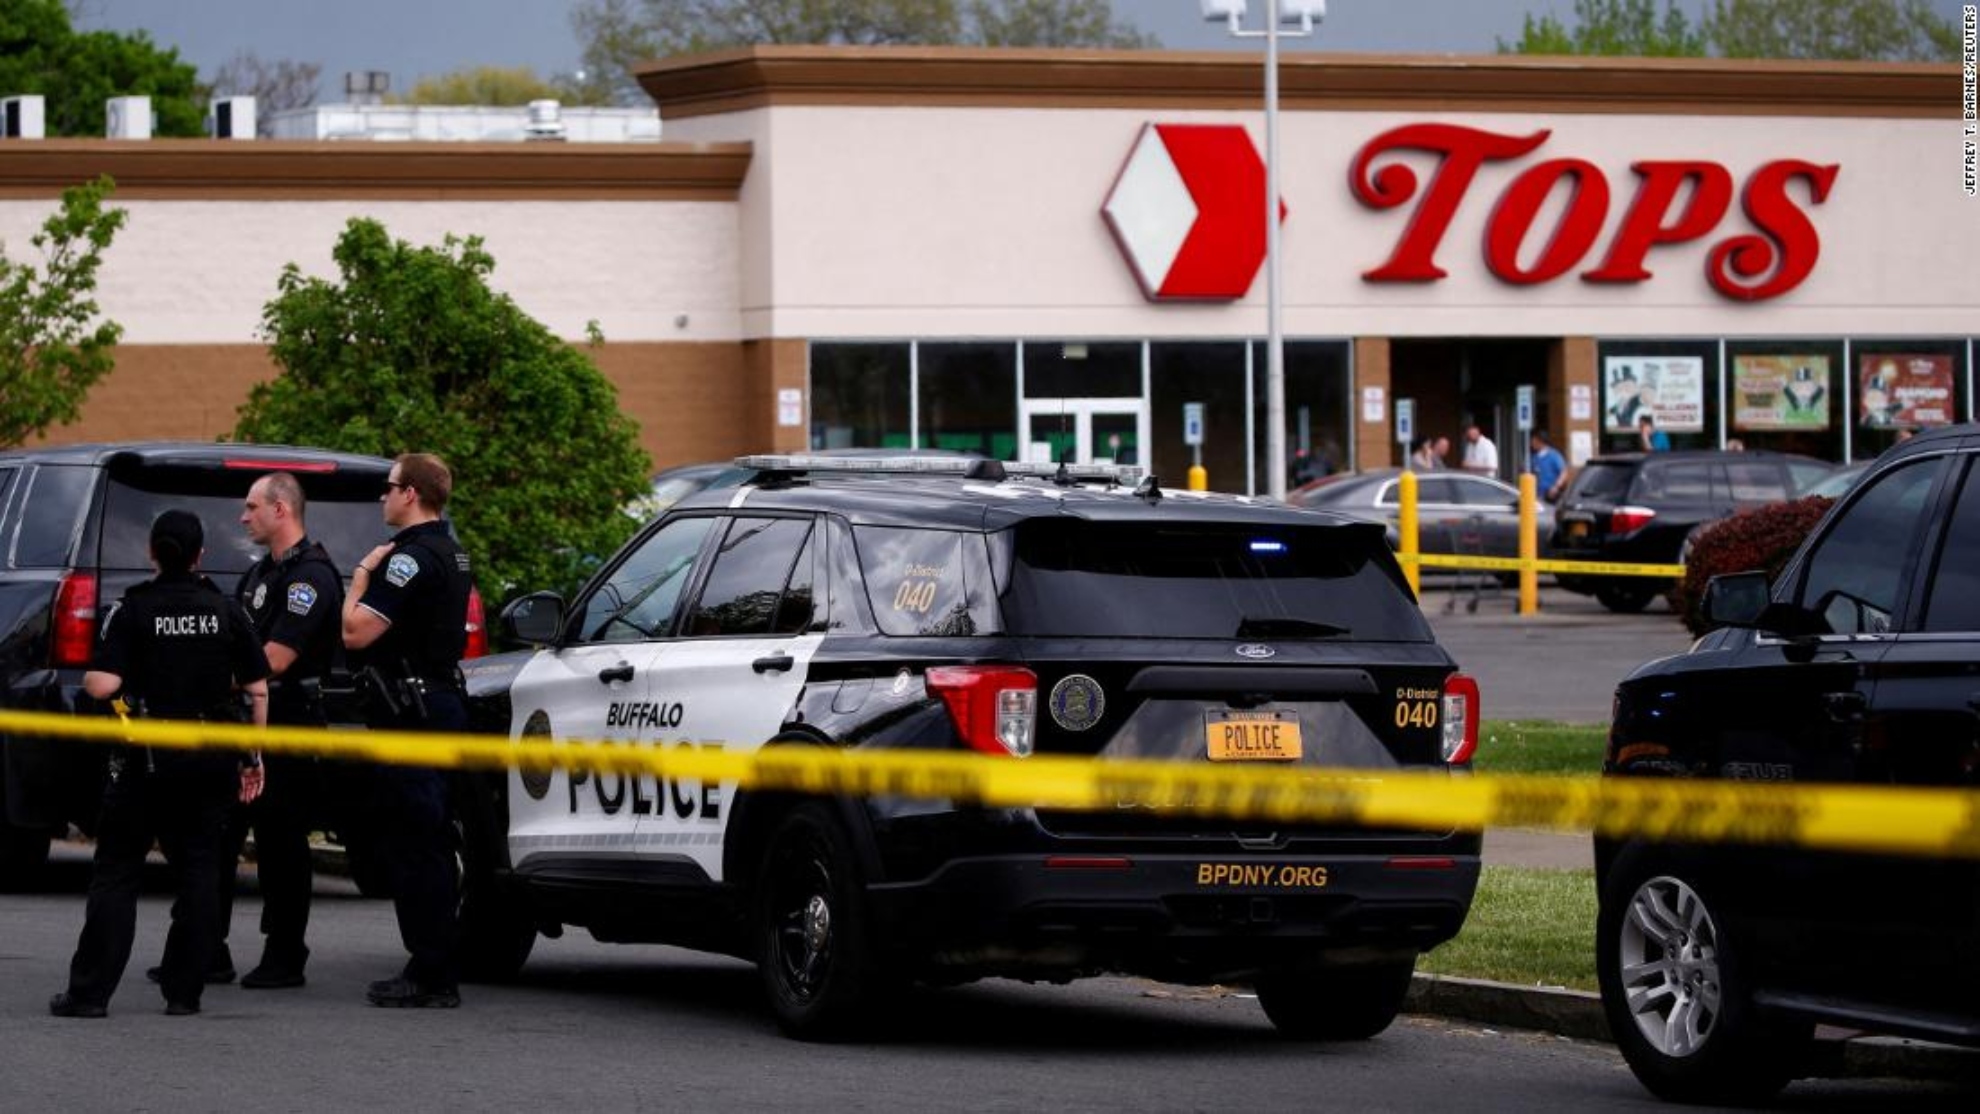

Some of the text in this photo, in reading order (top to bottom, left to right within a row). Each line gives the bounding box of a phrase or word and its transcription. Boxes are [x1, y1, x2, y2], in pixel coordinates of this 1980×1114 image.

[894, 580, 935, 612] 040
[155, 614, 218, 635] POLICE K-9
[606, 703, 683, 728] BUFFALO
[1396, 701, 1437, 728] 040
[1225, 725, 1282, 750] POLICE
[1198, 863, 1328, 886] BPDNY.ORG
